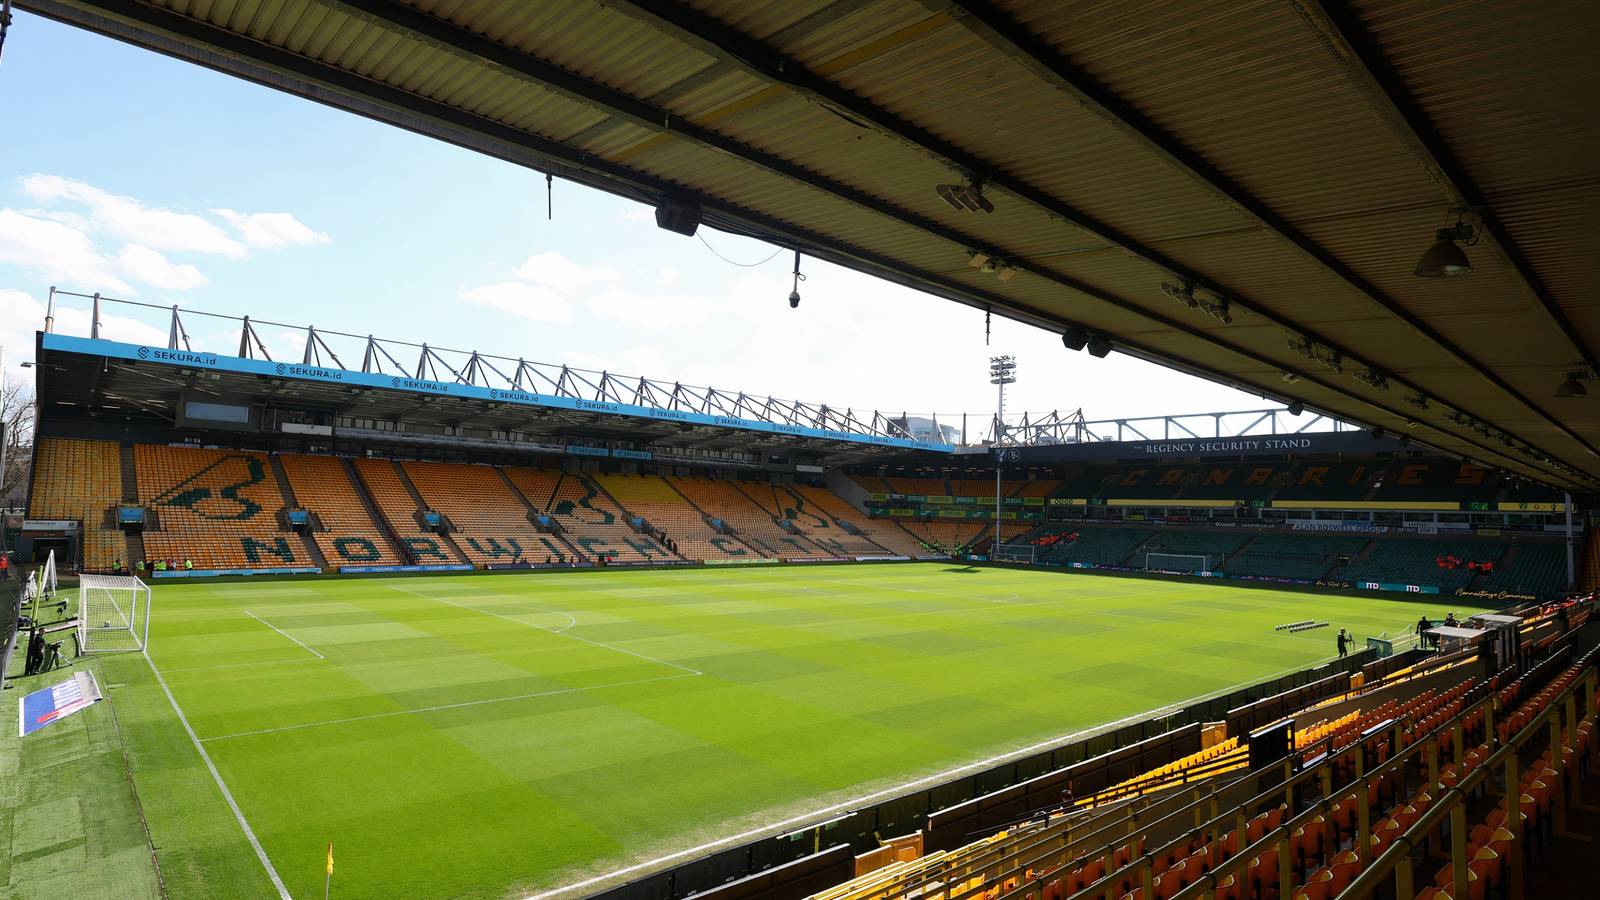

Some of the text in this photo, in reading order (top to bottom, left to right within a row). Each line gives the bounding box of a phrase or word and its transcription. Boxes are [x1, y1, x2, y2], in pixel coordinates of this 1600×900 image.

[154, 351, 216, 365] SEKURA.id
[289, 367, 341, 380] SEKURA.id
[403, 380, 448, 392] SEKURA.id
[499, 391, 538, 402] SEKURA.id
[583, 401, 617, 412] SEKURA.id
[1146, 443, 1195, 454] REGENCY
[1199, 440, 1260, 452] SECURITY
[1265, 438, 1311, 449] STAND
[1120, 464, 1488, 487] CANARIES
[240, 535, 668, 564] NORWICH
